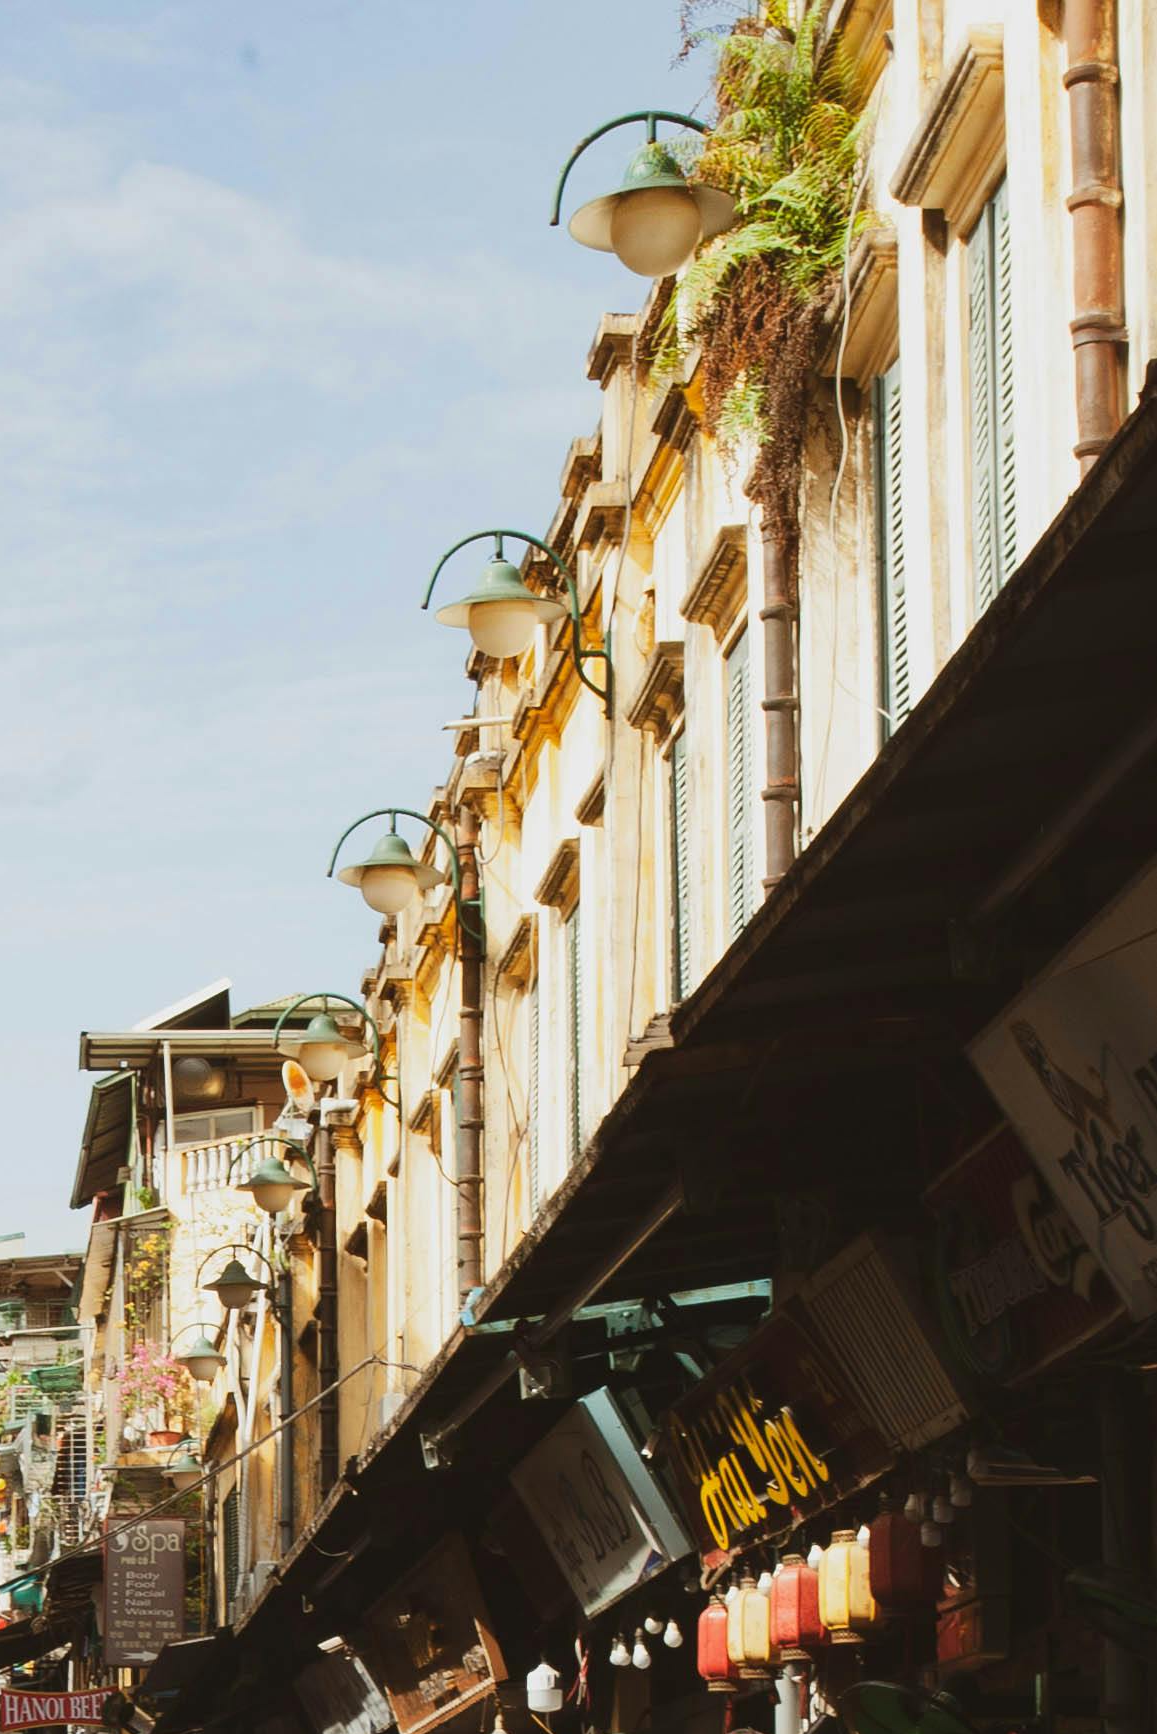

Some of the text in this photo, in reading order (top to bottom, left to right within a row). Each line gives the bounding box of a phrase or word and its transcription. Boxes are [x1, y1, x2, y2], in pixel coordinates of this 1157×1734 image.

[131, 1524, 182, 1565] Spa
[125, 1571, 160, 1582] Body
[125, 1580, 156, 1589] Foot
[125, 1589, 166, 1598] Facial
[125, 1598, 152, 1607] Nail
[124, 1608, 175, 1617] Waxing
[3, 1694, 66, 1725] HANOI
